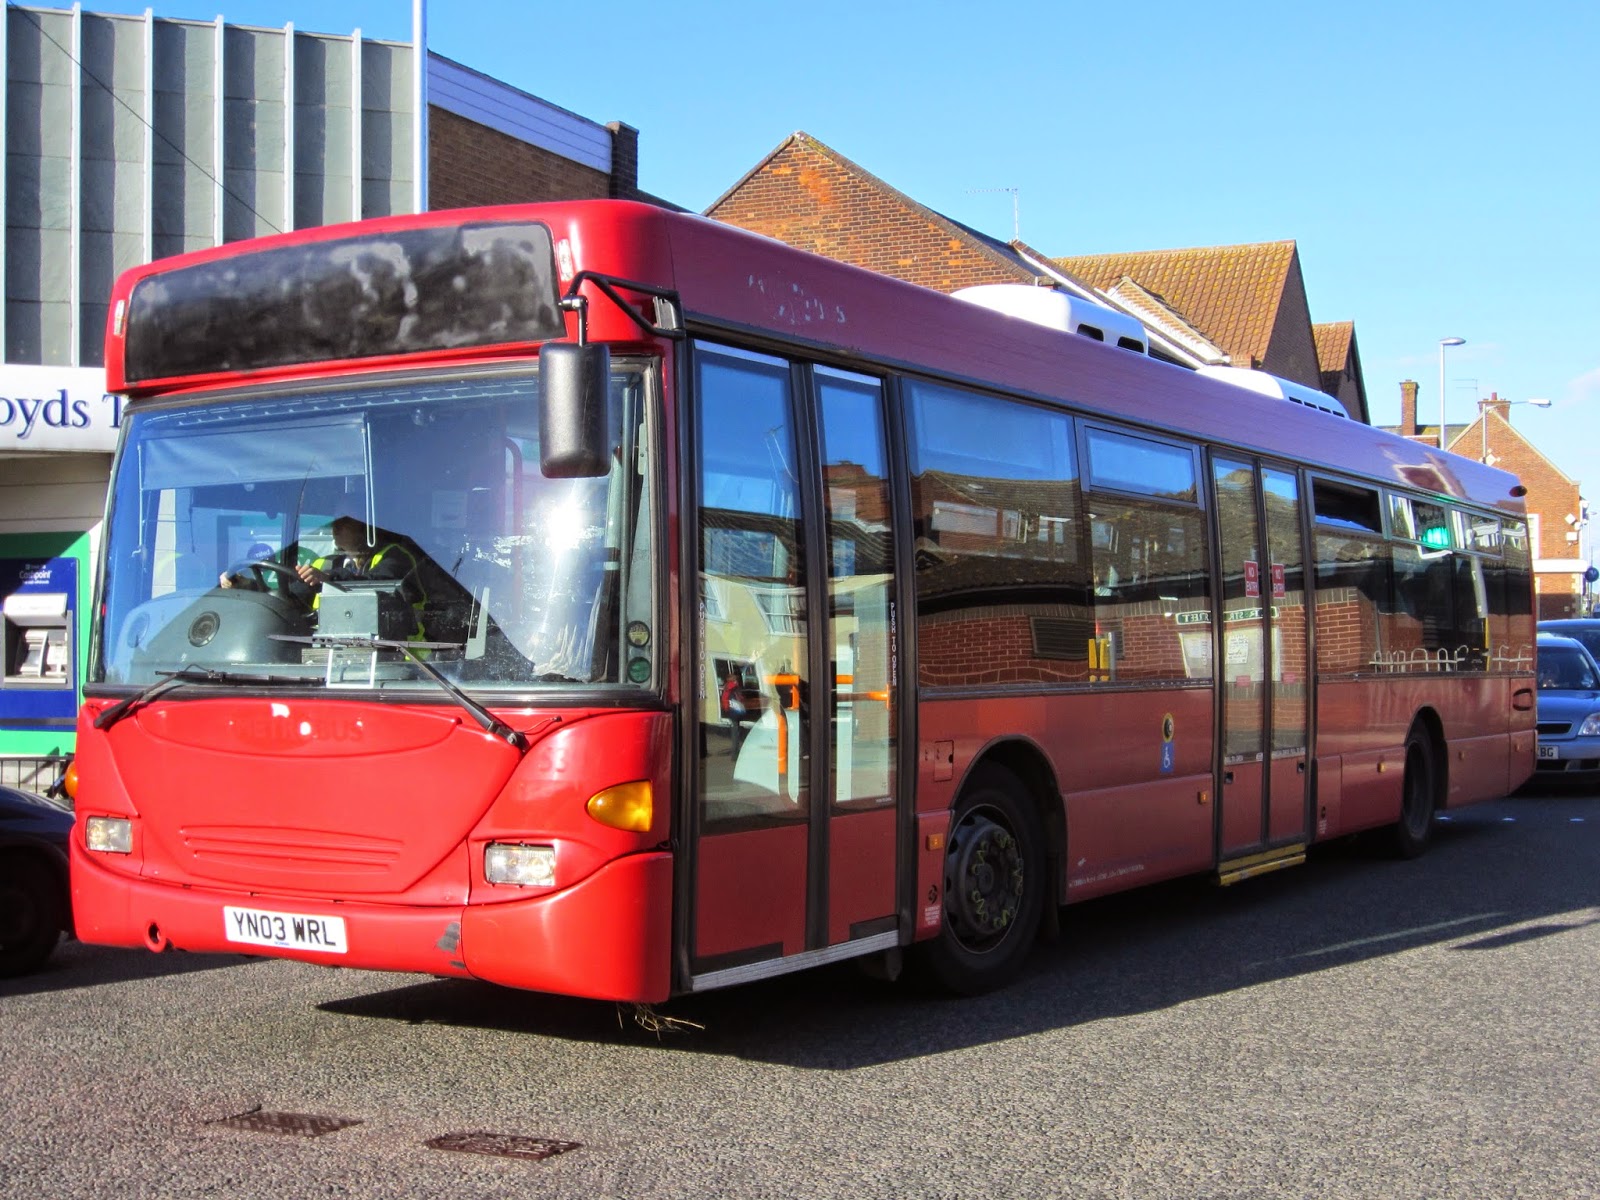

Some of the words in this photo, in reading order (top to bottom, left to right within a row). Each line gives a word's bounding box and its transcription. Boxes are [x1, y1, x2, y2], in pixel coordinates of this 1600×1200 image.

[891, 636, 897, 653] TO
[1537, 747, 1554, 758] BG
[232, 910, 287, 942] YN03
[291, 916, 337, 947] WRL
